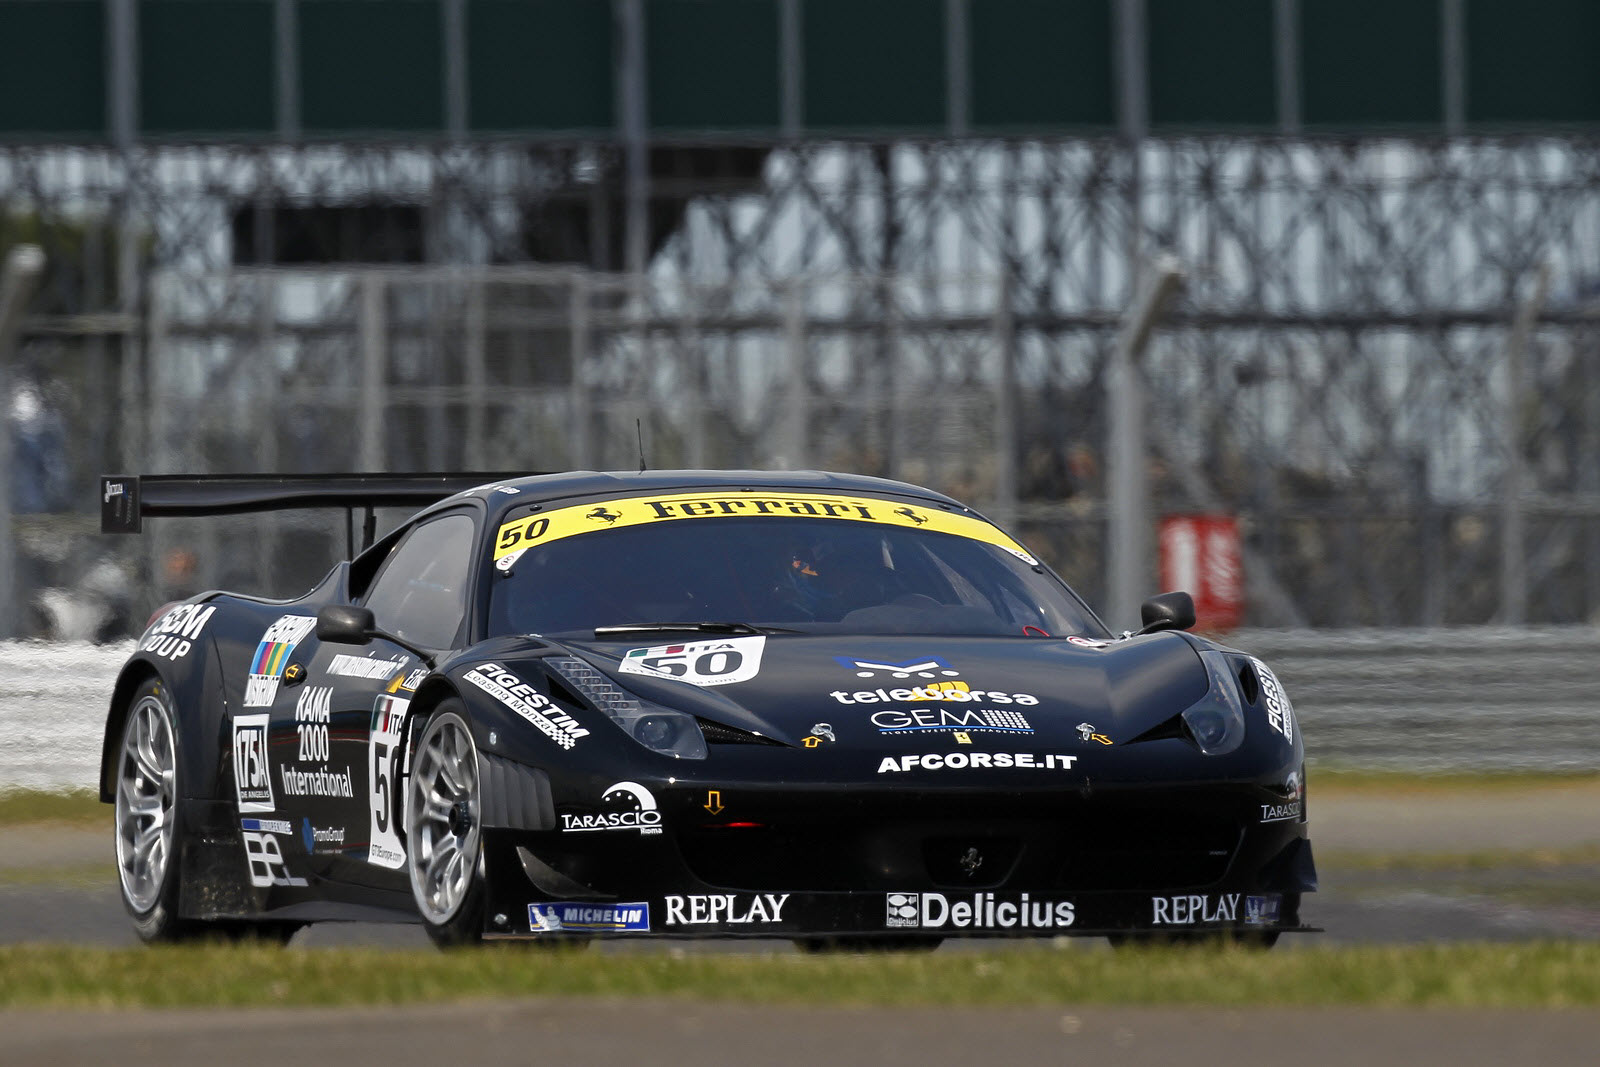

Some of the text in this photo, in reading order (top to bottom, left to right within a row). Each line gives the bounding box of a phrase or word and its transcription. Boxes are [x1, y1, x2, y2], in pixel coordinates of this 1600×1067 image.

[644, 497, 876, 520] Ferrari
[500, 518, 549, 549] 50
[688, 643, 735, 653] ITA
[641, 651, 743, 677] 50
[295, 685, 334, 724] RAMA
[466, 669, 510, 701] Leasing
[510, 698, 552, 733] Monza
[475, 662, 590, 739] FIGESTIM
[829, 686, 1040, 706] teleborsa
[871, 708, 988, 729] GEM
[297, 724, 330, 762] 2000
[877, 753, 1078, 773] AFCORSE.IT
[280, 763, 354, 798] International
[561, 810, 661, 830] TARASCIO
[640, 827, 663, 836] Roma
[563, 907, 642, 924] MICHELIN
[664, 893, 791, 926] REPLAY
[922, 893, 1075, 927] Delicius
[1152, 893, 1240, 925] REPLAY
